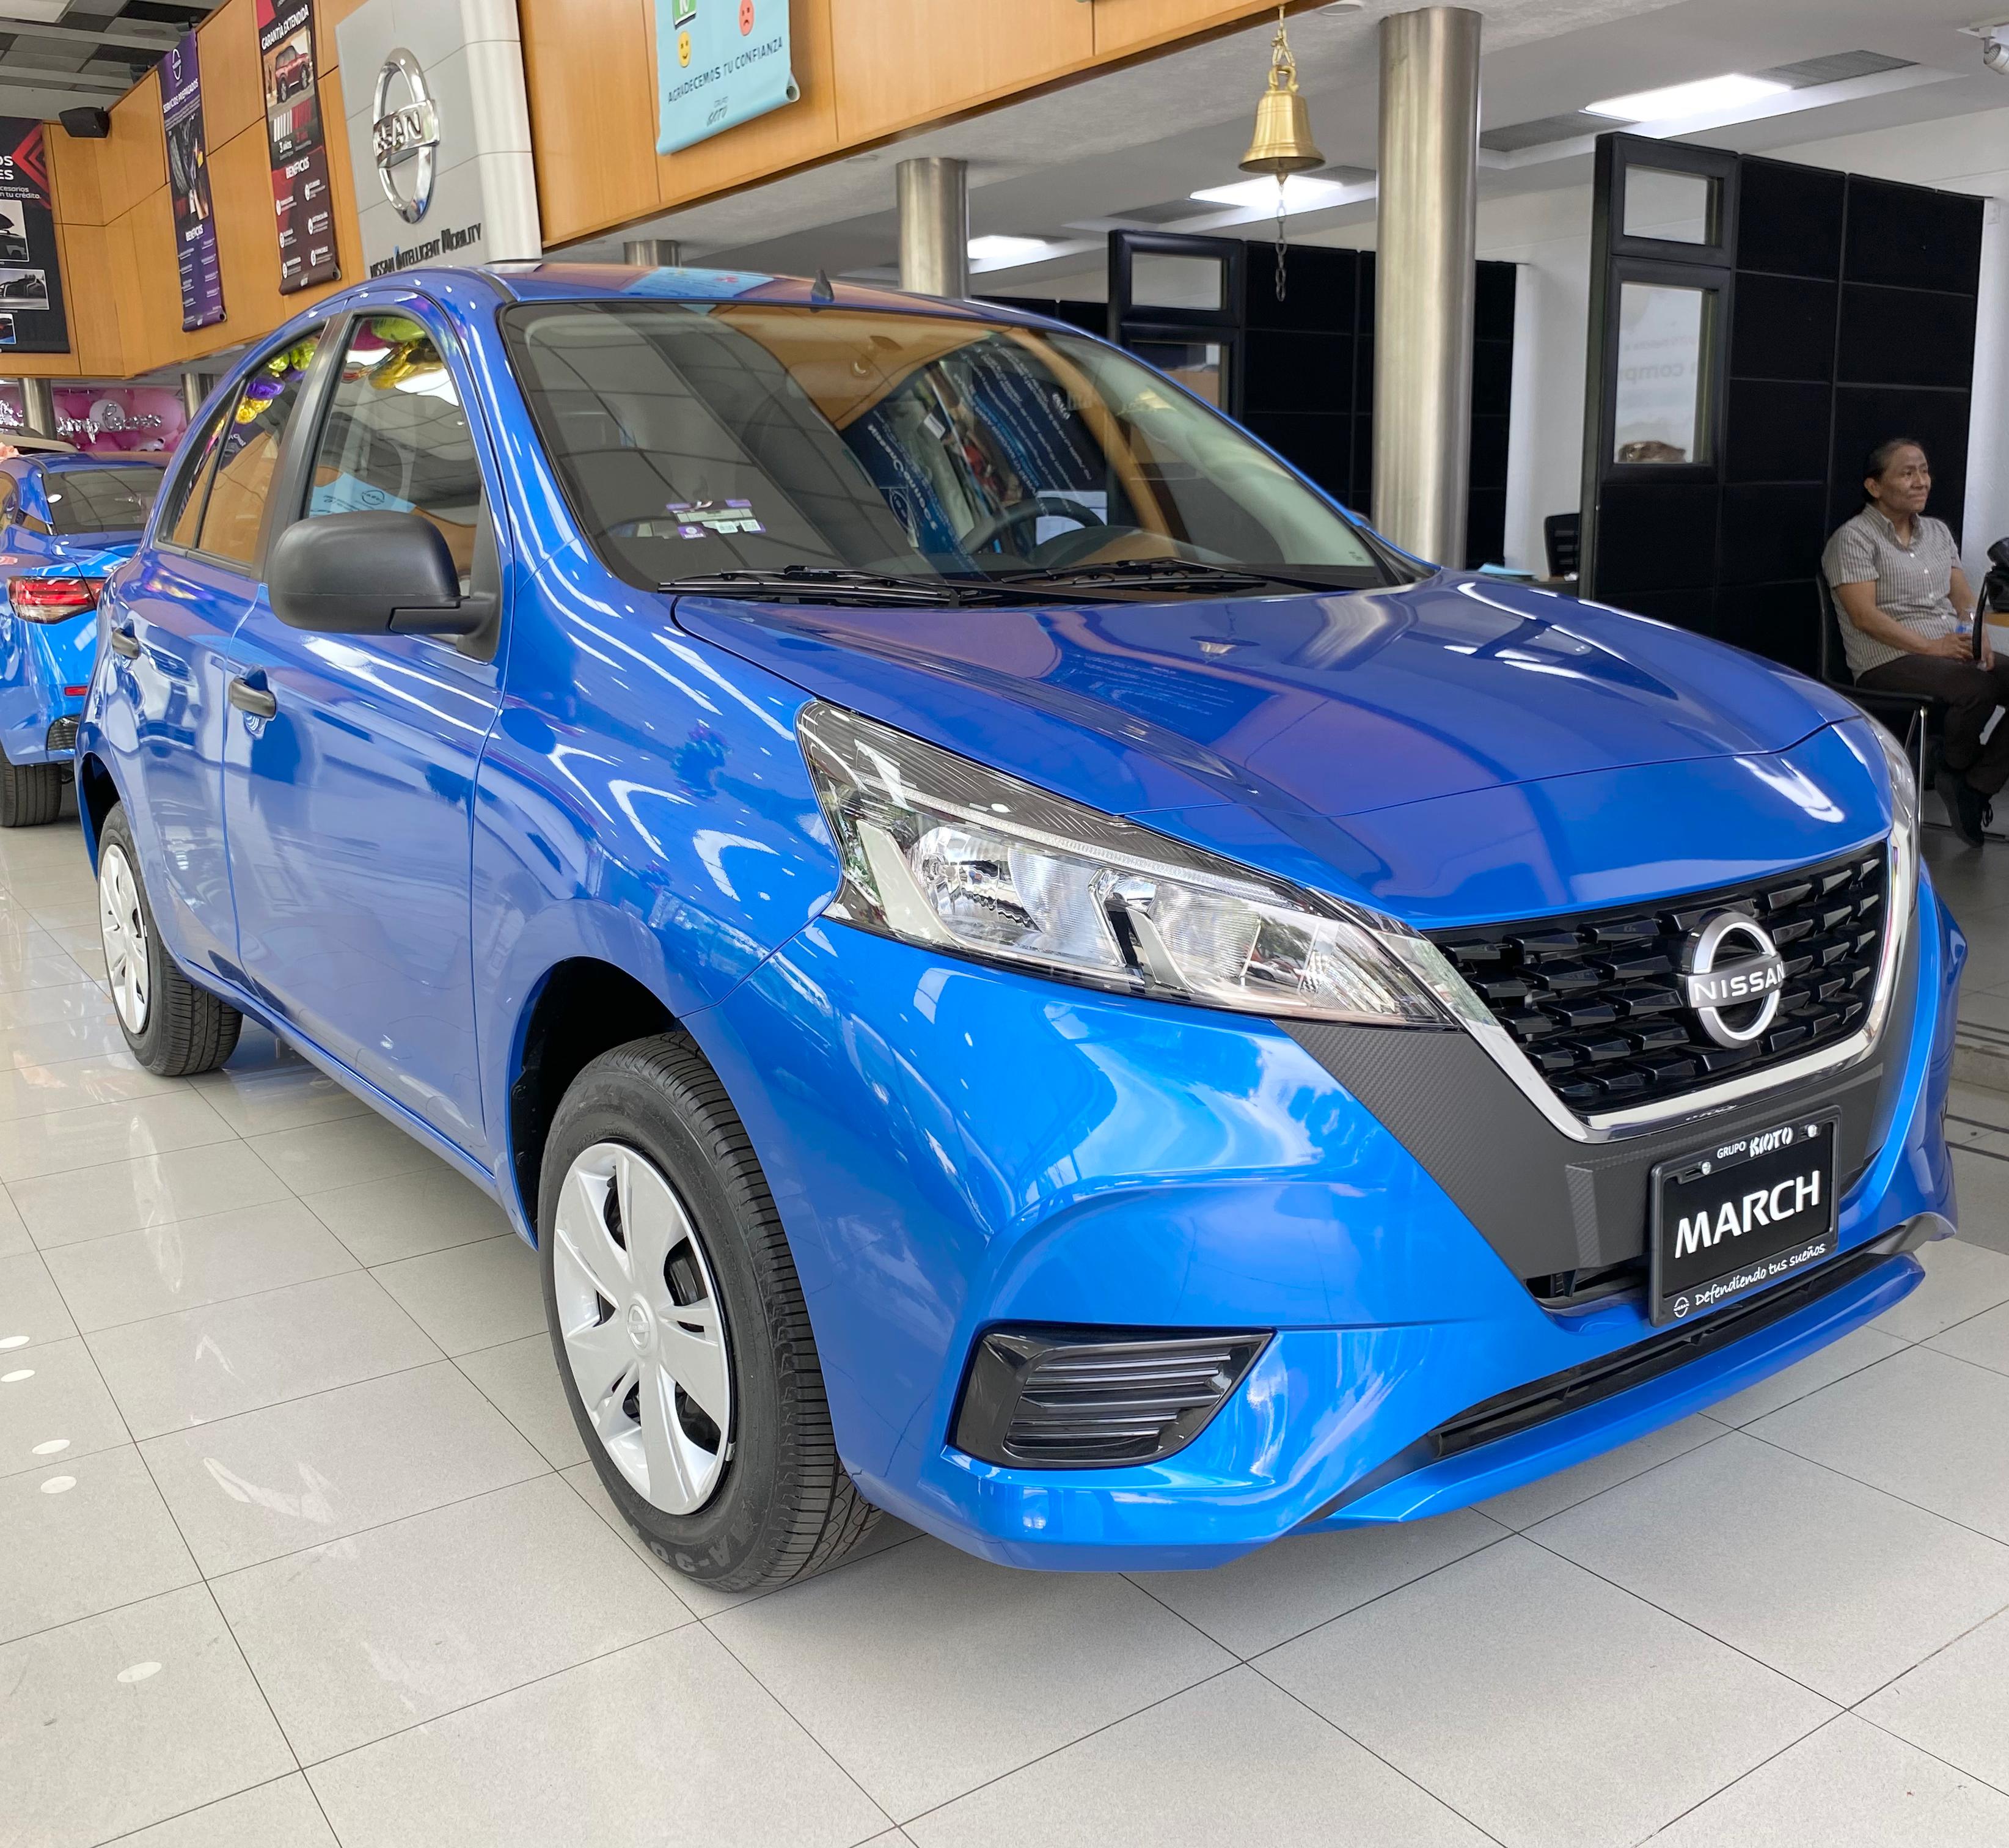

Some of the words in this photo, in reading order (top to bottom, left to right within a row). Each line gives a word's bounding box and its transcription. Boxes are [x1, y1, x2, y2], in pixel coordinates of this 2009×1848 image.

[262, 23, 284, 50] GARANTÍA
[284, 4, 309, 35] EXTENDIDA
[668, 67, 720, 104] AGRADECEMOS
[723, 60, 734, 76] TU
[735, 37, 783, 70] CONFIANZA
[370, 257, 395, 279] NISSAN
[394, 245, 440, 270] INTELLIGENT
[441, 223, 481, 254] MOBILITY
[1694, 961, 1786, 1002] NISSAN
[1717, 1140, 1746, 1159] GRUPO
[1749, 1127, 1793, 1157] KIOTO
[1674, 1170, 1821, 1259] MARCH
[1694, 1266, 1766, 1307] Defendiendo
[1768, 1259, 1788, 1275] tus
[1788, 1243, 1826, 1267] sueños
